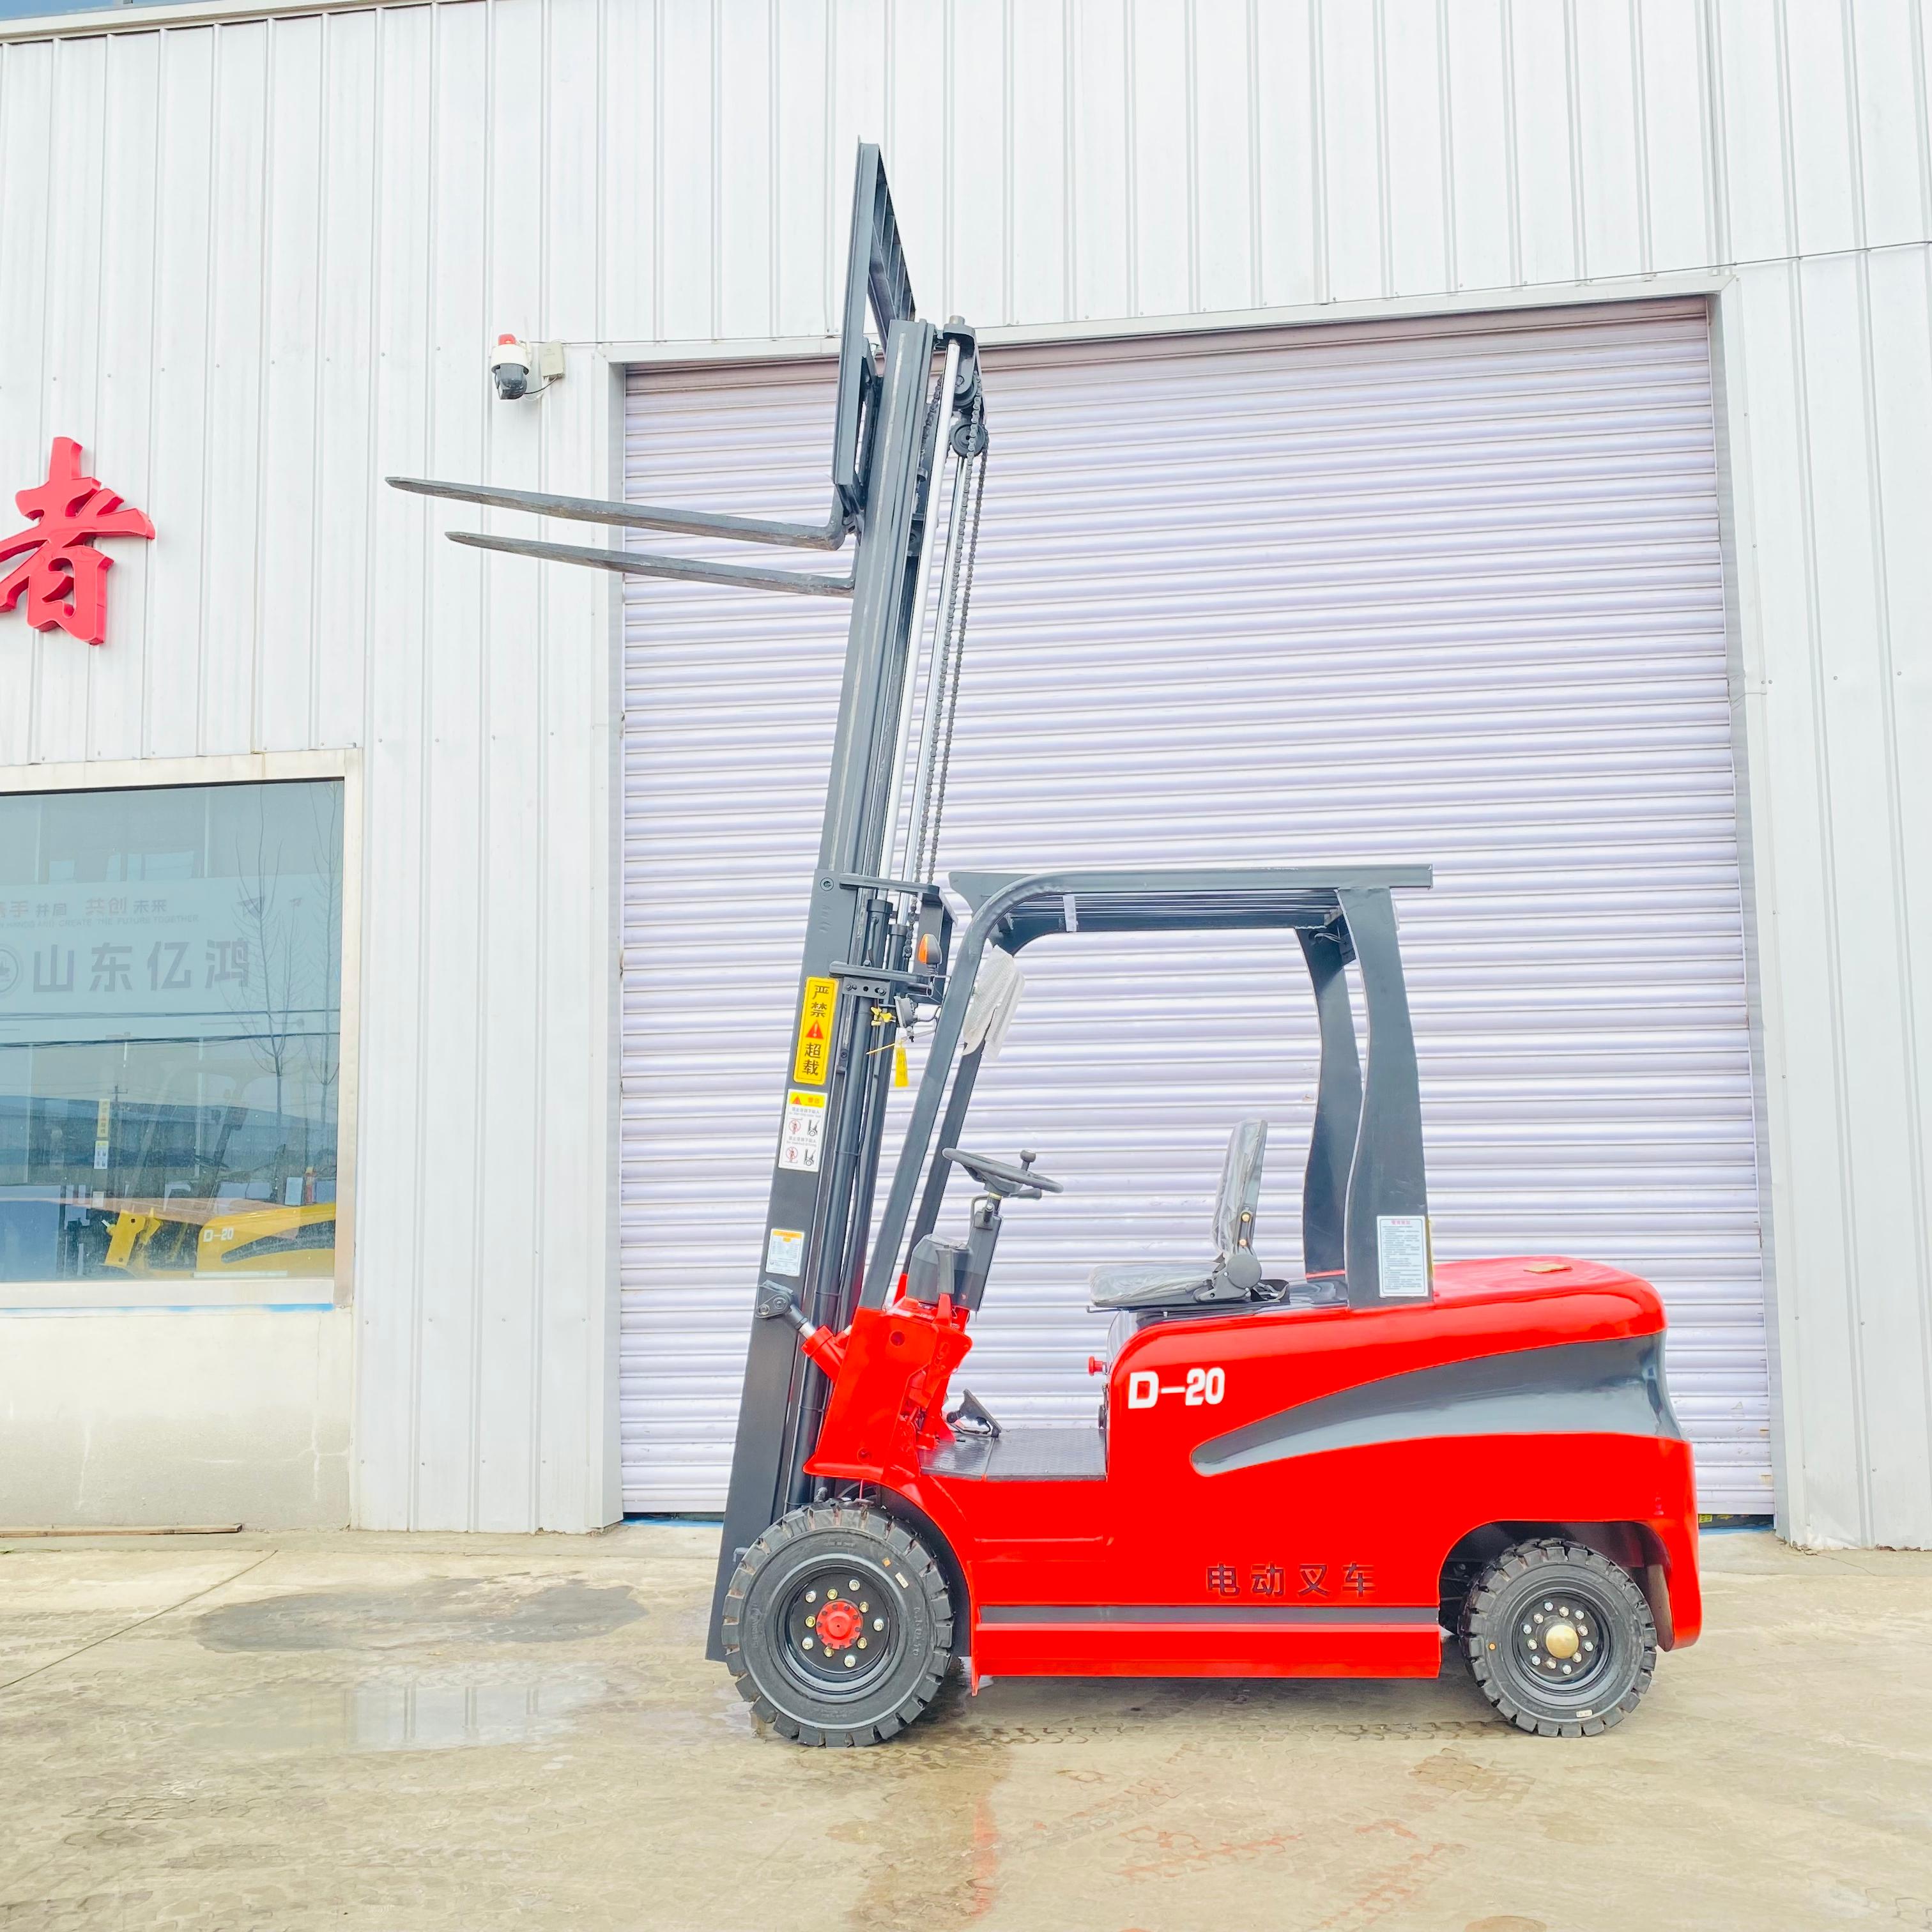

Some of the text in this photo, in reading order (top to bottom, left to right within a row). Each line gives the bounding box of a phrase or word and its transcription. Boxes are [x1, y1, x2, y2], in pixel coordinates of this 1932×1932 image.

[0, 435, 157, 645] 者
[33, 939, 250, 993] 山东亿鸿
[1128, 1367, 1226, 1409] D-20
[1206, 1562, 1377, 1597] 电动叉车
